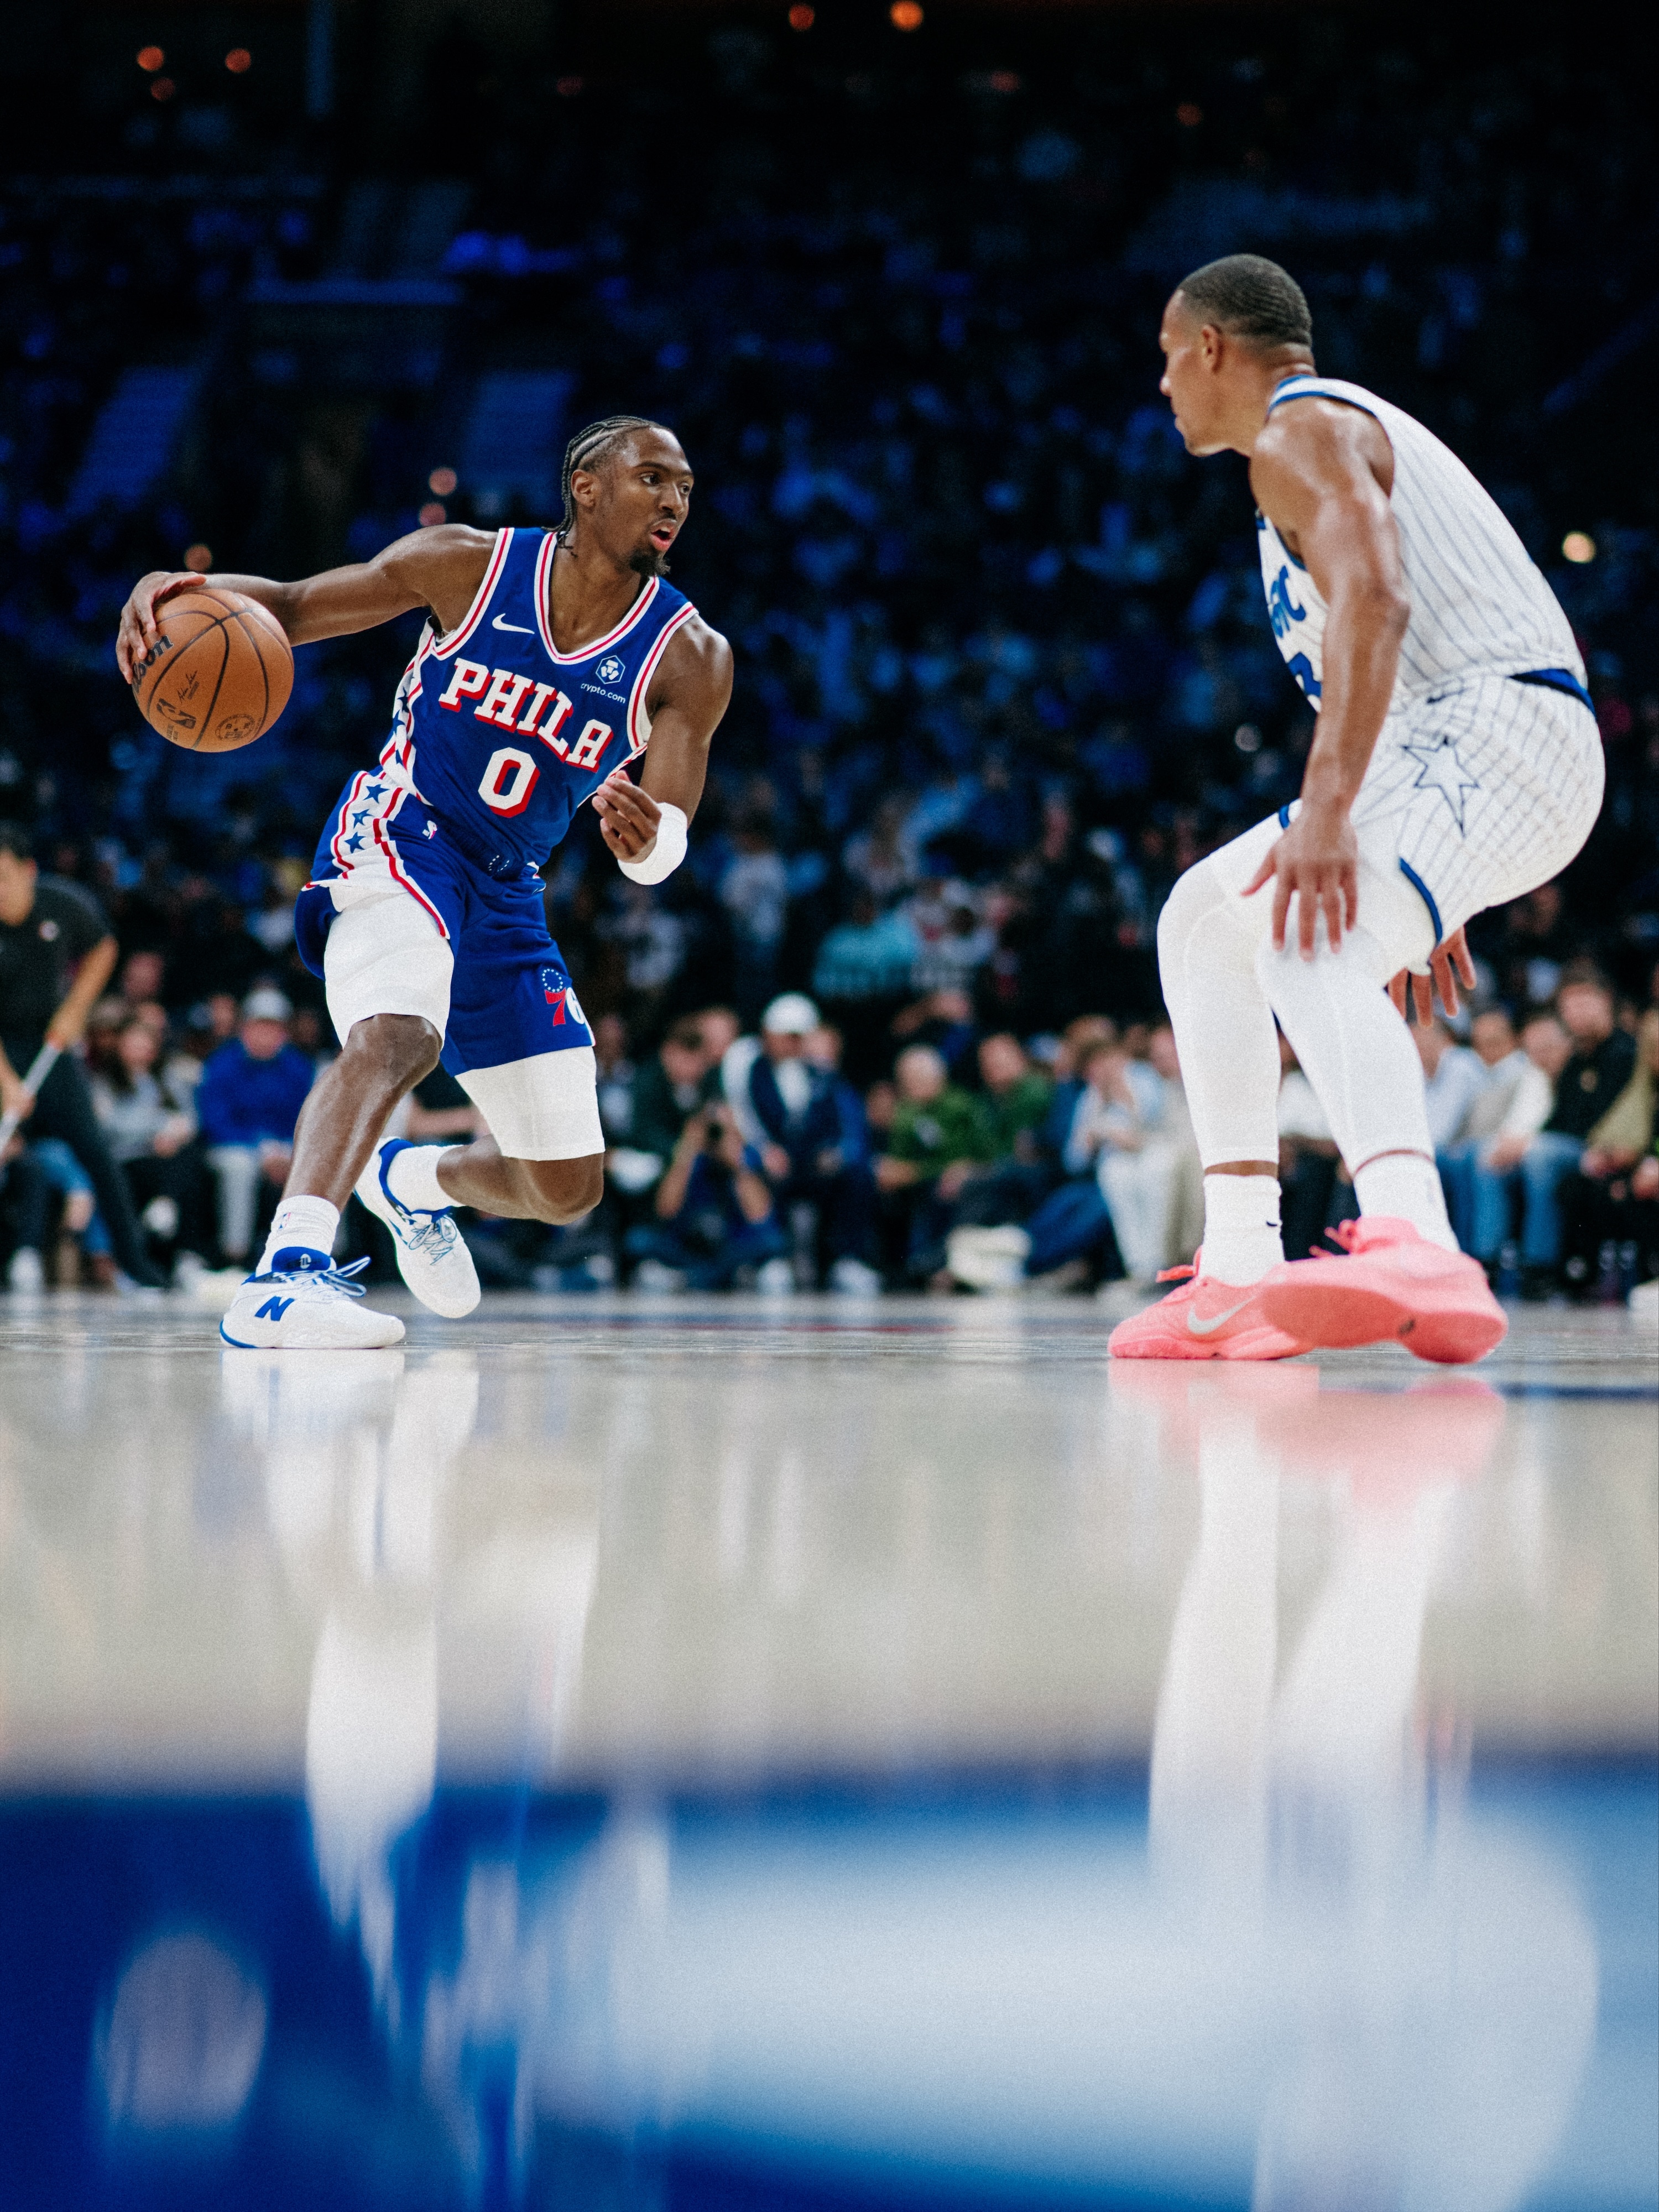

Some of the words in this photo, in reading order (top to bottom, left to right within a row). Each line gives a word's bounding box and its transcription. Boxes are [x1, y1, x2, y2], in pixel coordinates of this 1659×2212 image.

[439, 657, 614, 773] PHILA
[580, 683, 626, 704] crypto.com
[478, 747, 541, 818] 0
[254, 1296, 295, 1322] N
